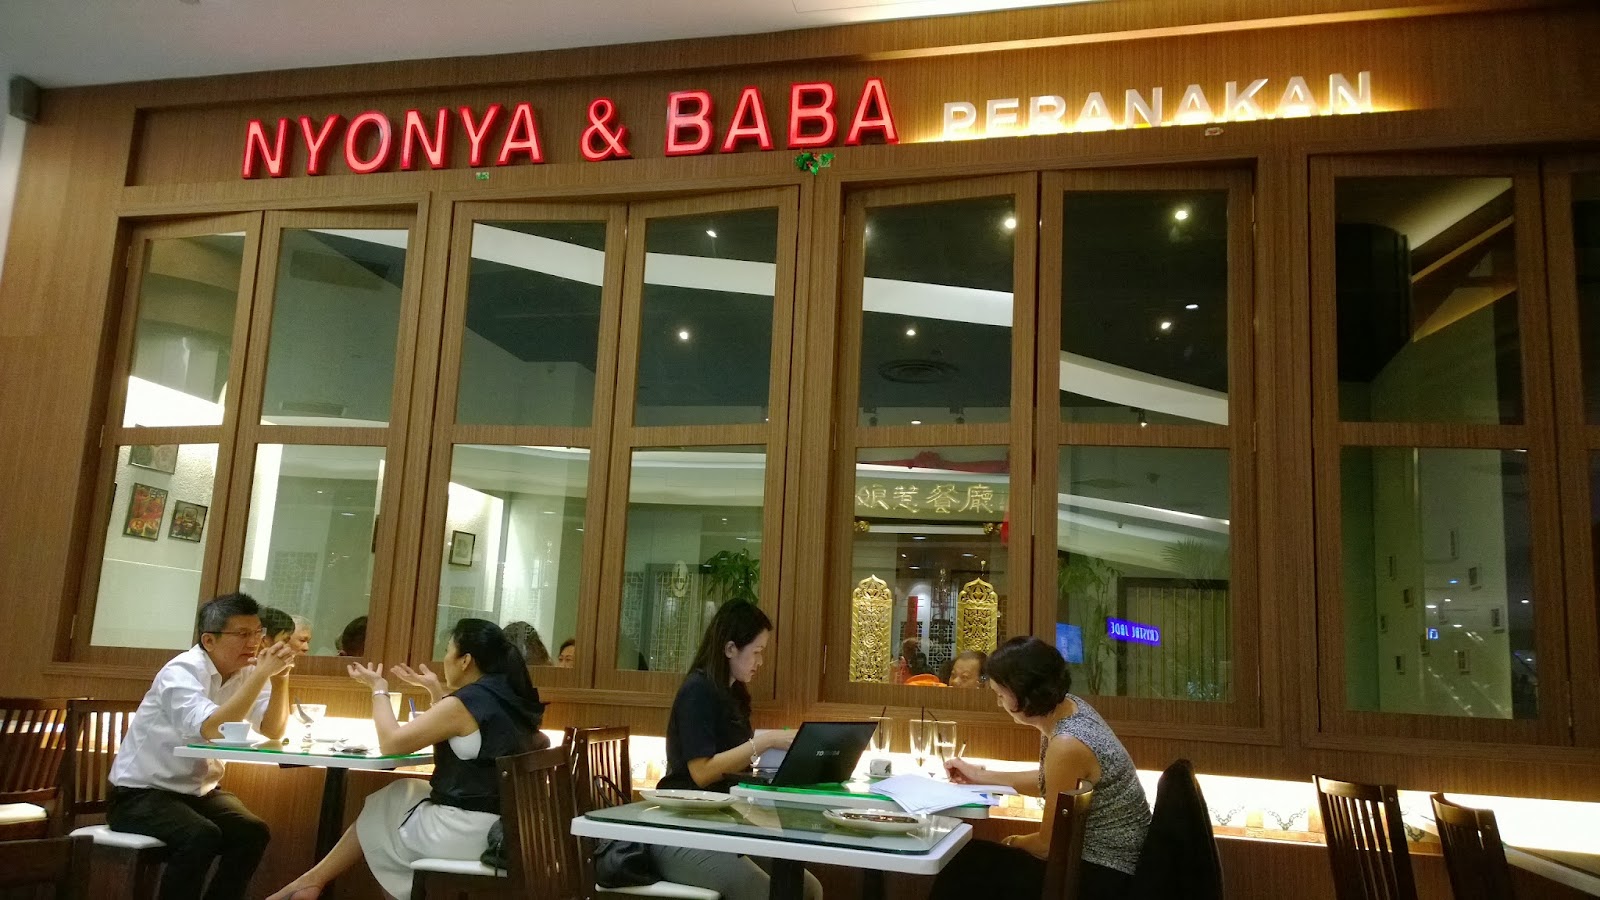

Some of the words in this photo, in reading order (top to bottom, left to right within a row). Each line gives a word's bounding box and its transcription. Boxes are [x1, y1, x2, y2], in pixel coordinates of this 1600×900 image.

[243, 102, 543, 178] NYONYA
[580, 98, 629, 161] &
[665, 78, 899, 156] BABA
[943, 71, 1371, 141] PERANAKAN
